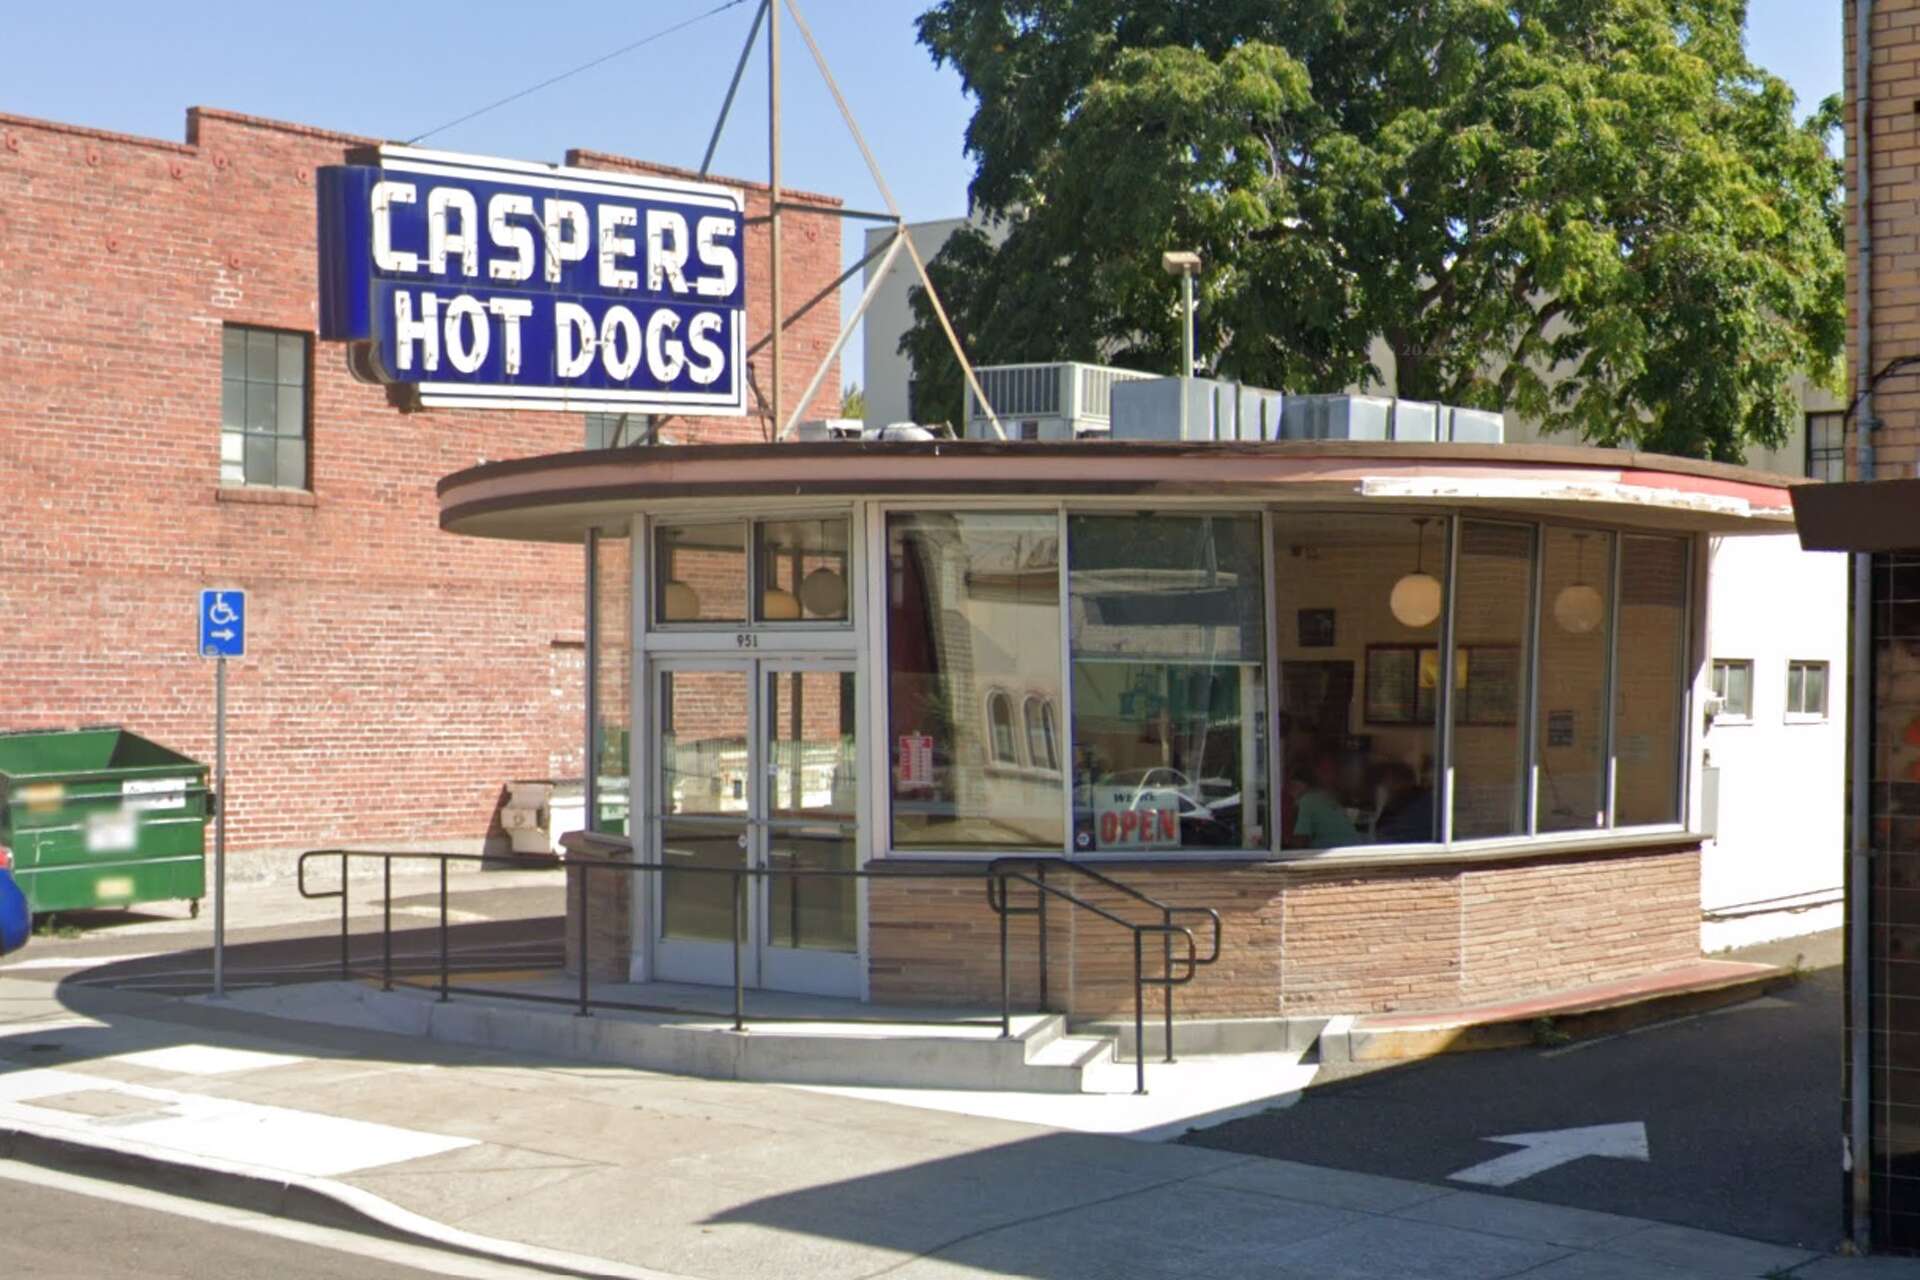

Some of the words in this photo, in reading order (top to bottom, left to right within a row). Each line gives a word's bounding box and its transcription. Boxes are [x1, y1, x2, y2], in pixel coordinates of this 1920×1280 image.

[371, 181, 739, 296] CASPERS
[394, 290, 534, 375] HOT
[554, 301, 726, 385] DOGS
[736, 634, 758, 648] 951
[1101, 808, 1176, 843] OPEN
